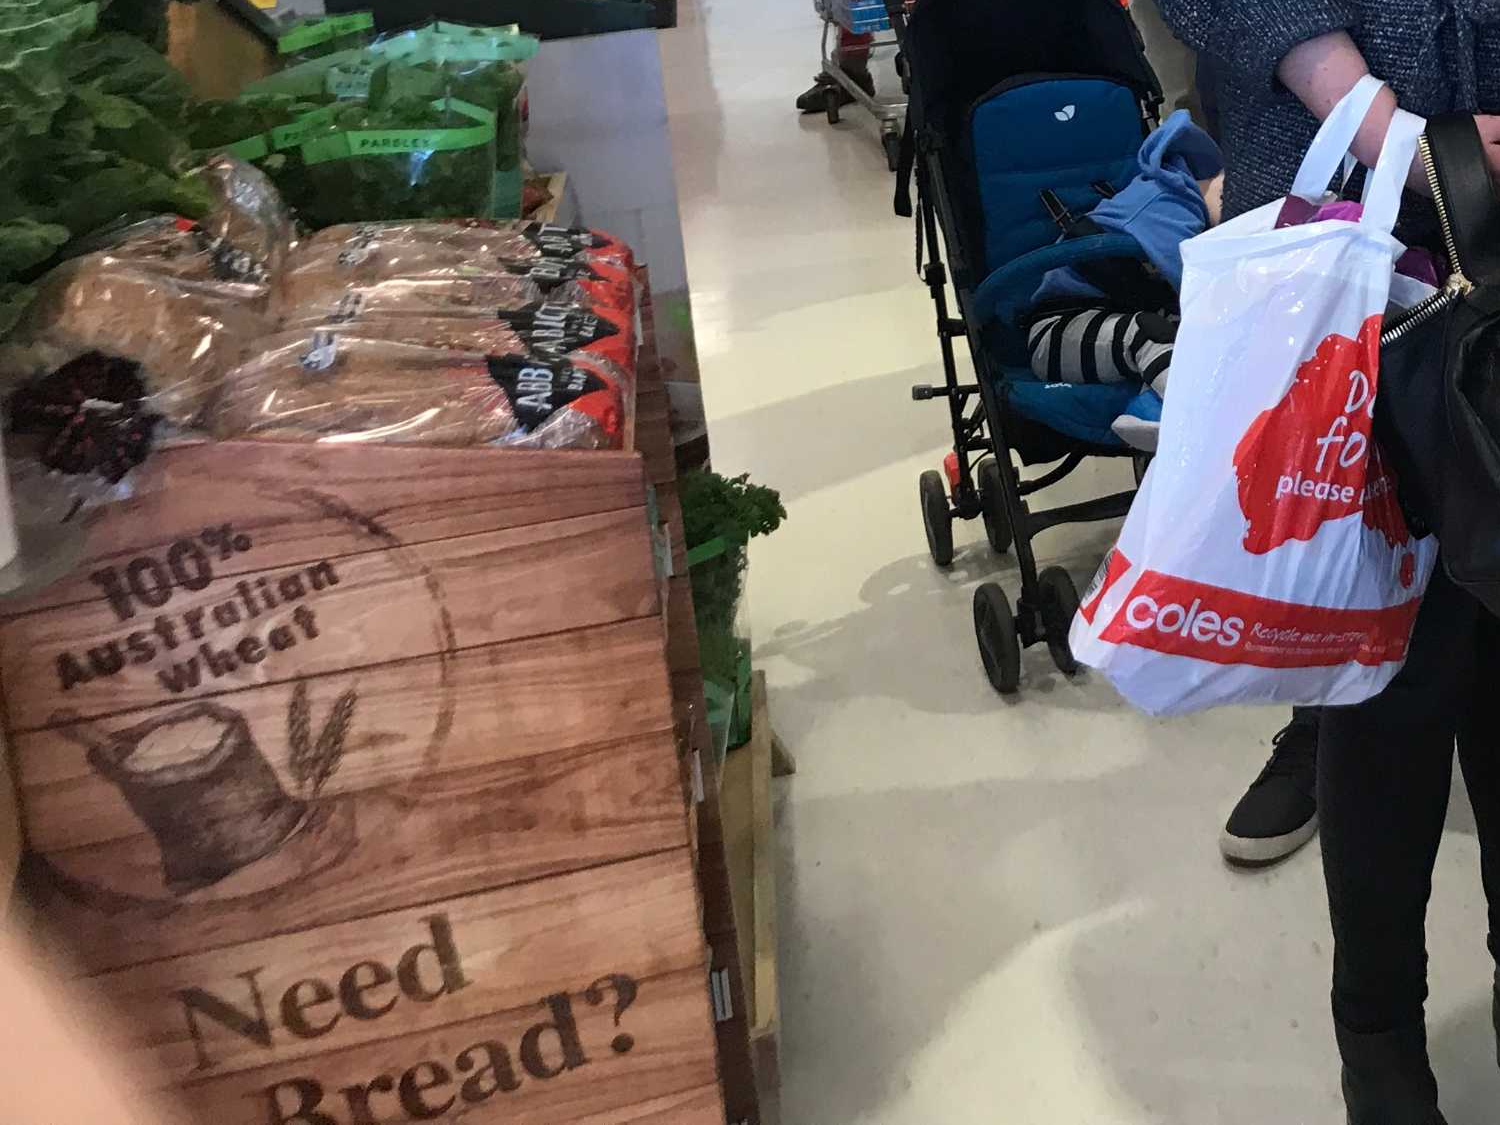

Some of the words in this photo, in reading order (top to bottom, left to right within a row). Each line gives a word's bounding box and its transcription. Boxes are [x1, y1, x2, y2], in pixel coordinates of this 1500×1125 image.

[1274, 471, 1355, 504] please
[1315, 416, 1370, 473] fo
[90, 522, 252, 621] 100%
[56, 560, 340, 691] Australian
[156, 604, 320, 694] wheat
[1125, 594, 1245, 647] coles
[172, 911, 474, 1073] Need
[242, 972, 639, 1125] Bread?
